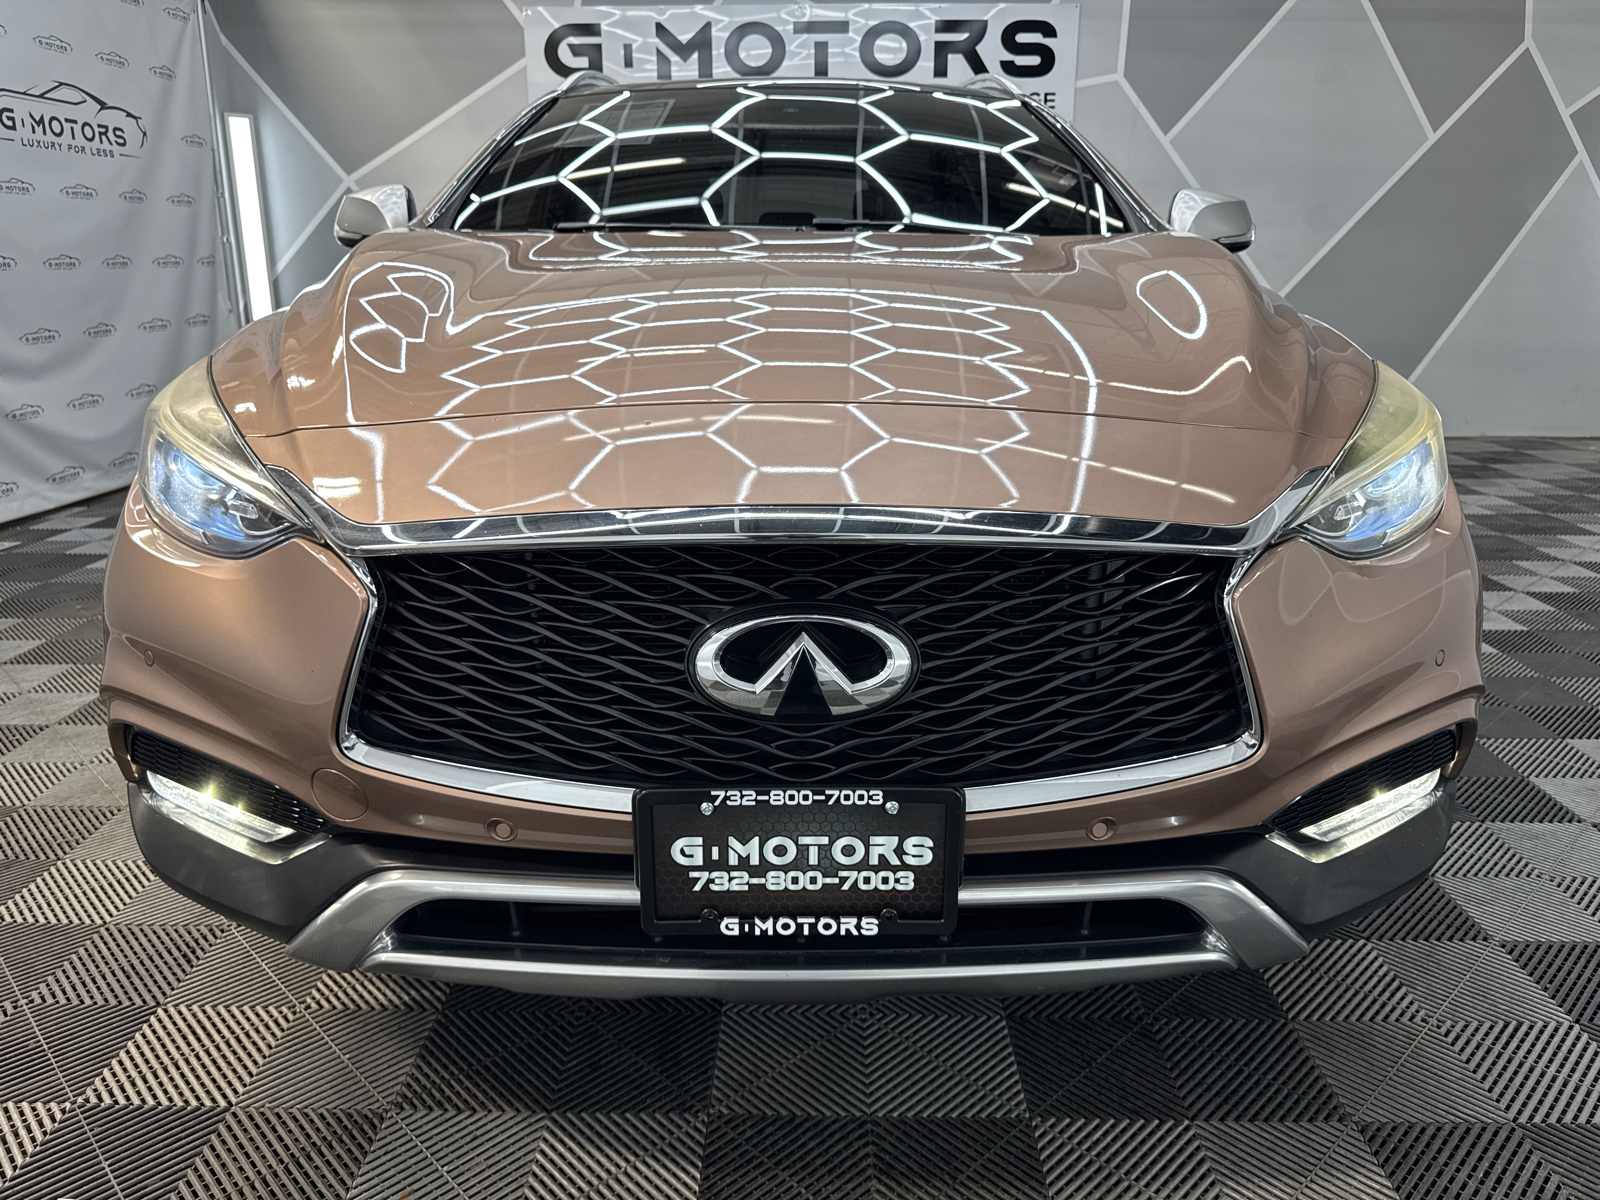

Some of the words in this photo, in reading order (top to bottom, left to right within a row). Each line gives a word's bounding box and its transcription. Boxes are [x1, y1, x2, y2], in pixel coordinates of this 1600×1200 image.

[20, 137, 63, 152] LUXURY
[67, 143, 87, 155] FOR
[90, 147, 115, 158] LESS
[710, 790, 884, 806] 732-800-7003
[688, 870, 915, 892] 732-800-7003
